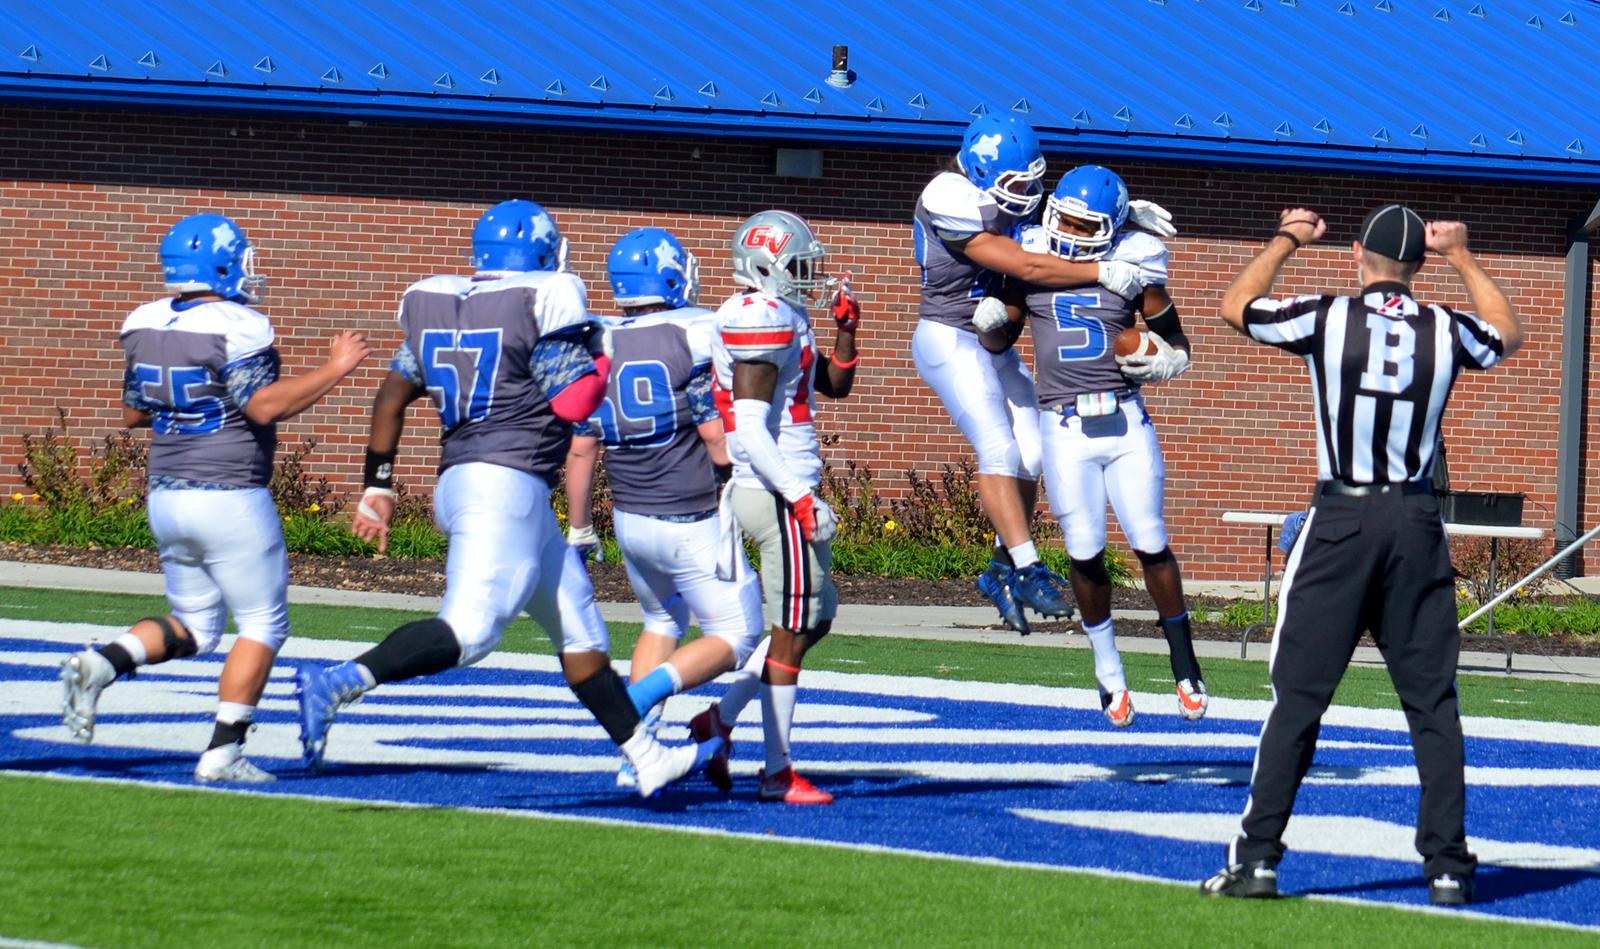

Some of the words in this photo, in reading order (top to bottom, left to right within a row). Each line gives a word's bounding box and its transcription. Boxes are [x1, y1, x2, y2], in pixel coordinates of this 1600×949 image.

[742, 225, 793, 257] GV
[1051, 293, 1107, 362] 5
[1360, 312, 1416, 394] B
[420, 328, 503, 431] 57
